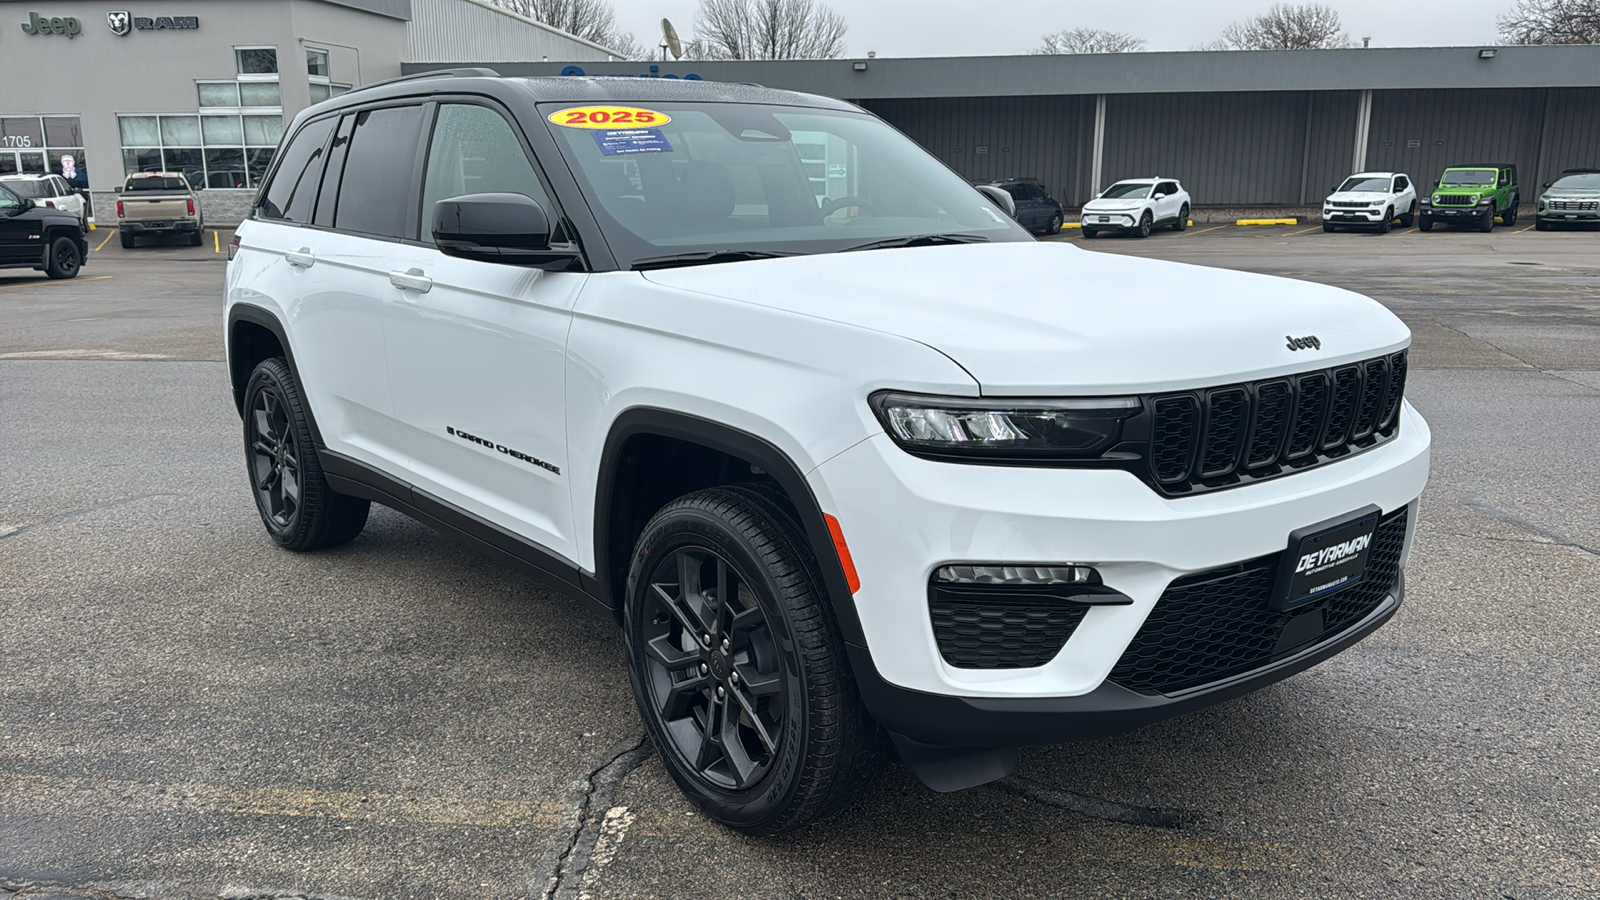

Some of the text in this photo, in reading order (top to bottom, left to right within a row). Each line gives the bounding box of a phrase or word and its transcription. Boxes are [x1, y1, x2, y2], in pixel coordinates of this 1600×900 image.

[21, 12, 80, 39] Jeep
[134, 17, 198, 30] RAM
[566, 111, 656, 124] 2025
[3, 136, 31, 147] 1705
[1286, 335, 1321, 351] Jeep
[456, 430, 561, 475] GRAND CHEROKEE
[1295, 532, 1372, 573] DEYARMAN
